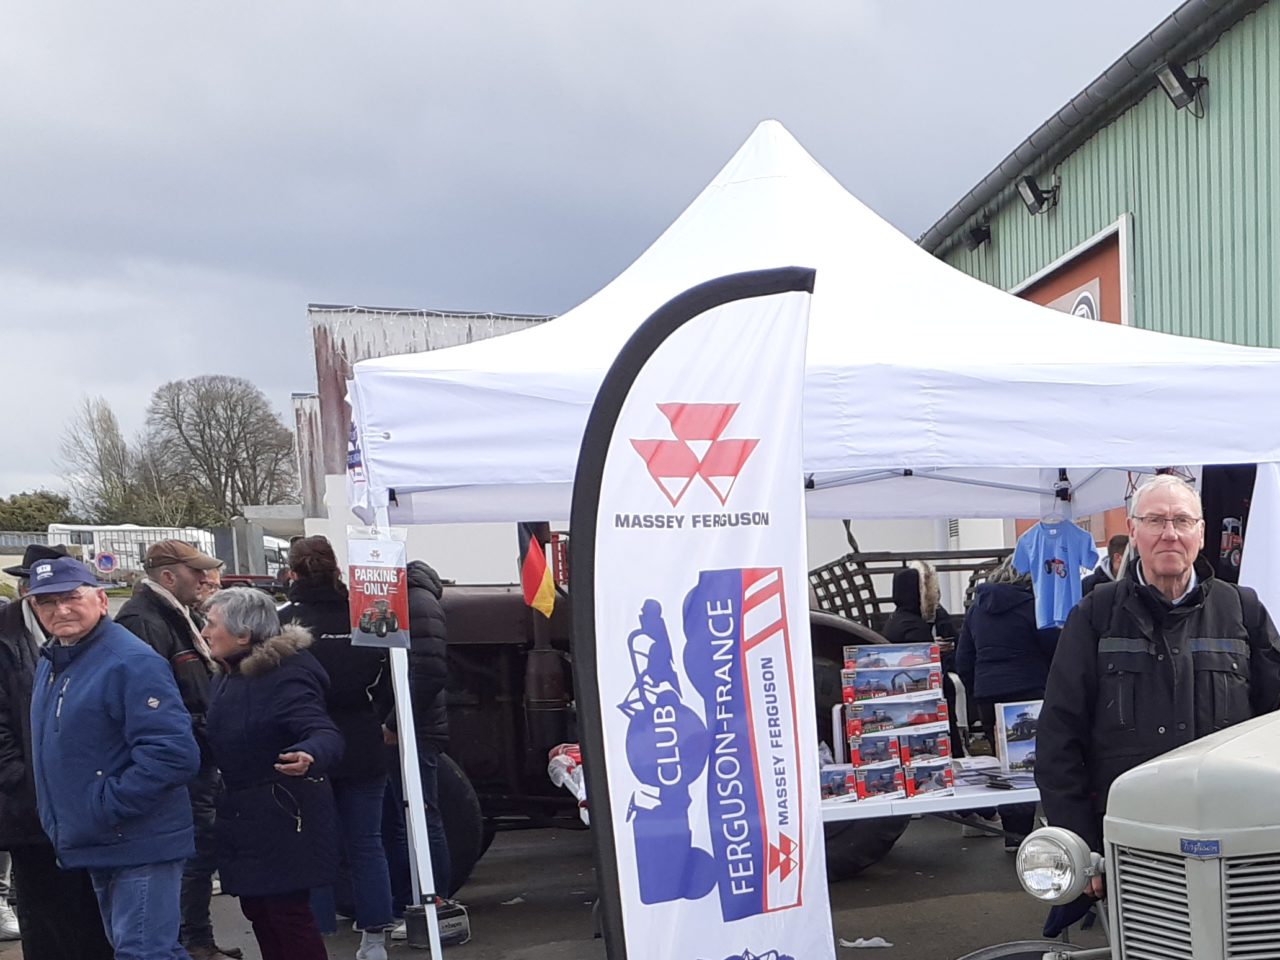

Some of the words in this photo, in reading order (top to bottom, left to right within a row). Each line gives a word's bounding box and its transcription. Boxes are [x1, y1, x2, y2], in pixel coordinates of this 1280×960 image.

[615, 513, 685, 529] MASSEY
[692, 511, 769, 528] FERGUSON
[354, 568, 398, 583] PARKING
[363, 582, 389, 595] ONLY
[760, 657, 784, 748] FERGUSON
[653, 705, 682, 786] CLUB
[706, 599, 754, 895] FERGUSON-FRANCE
[772, 756, 790, 825] MASSEY
